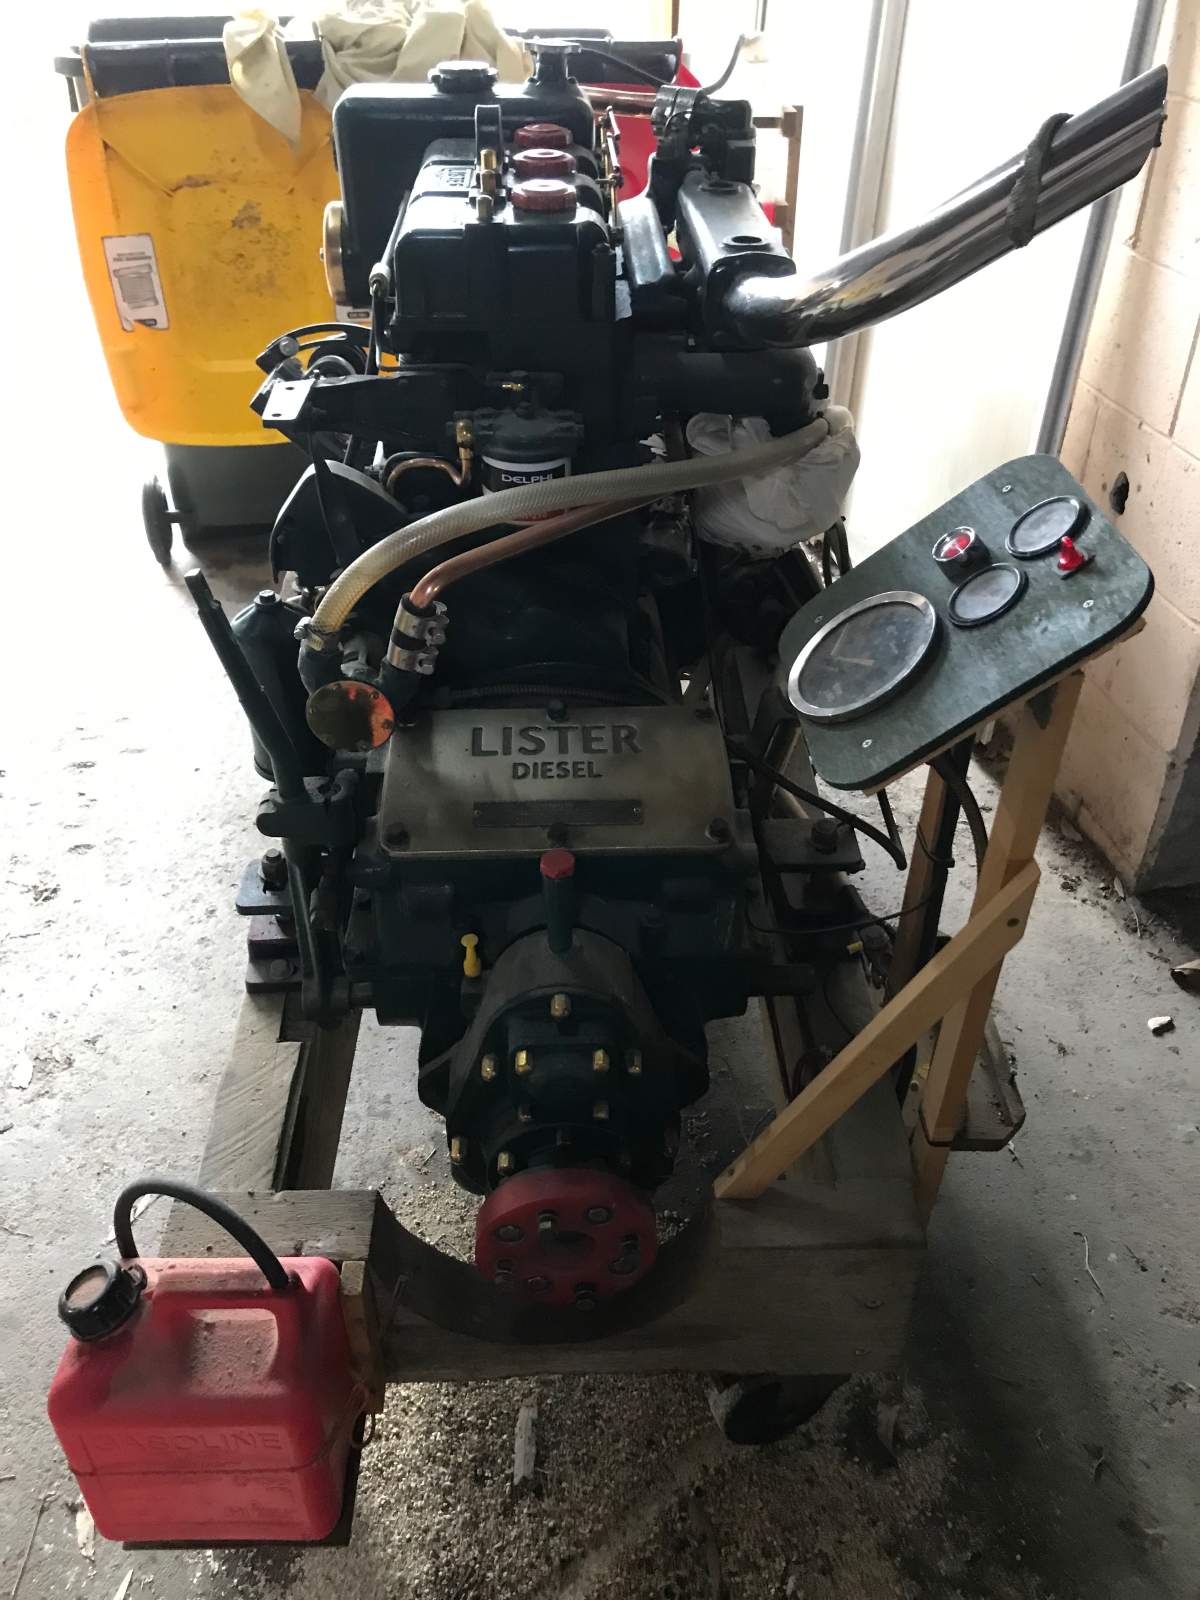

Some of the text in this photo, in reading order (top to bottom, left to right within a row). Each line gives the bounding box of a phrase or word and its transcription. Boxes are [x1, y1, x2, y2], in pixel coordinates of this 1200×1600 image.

[501, 473, 553, 484] DELPHI
[471, 723, 643, 757] LISTER
[511, 760, 603, 780] DIESEL
[96, 1431, 283, 1451] GASOLINE
